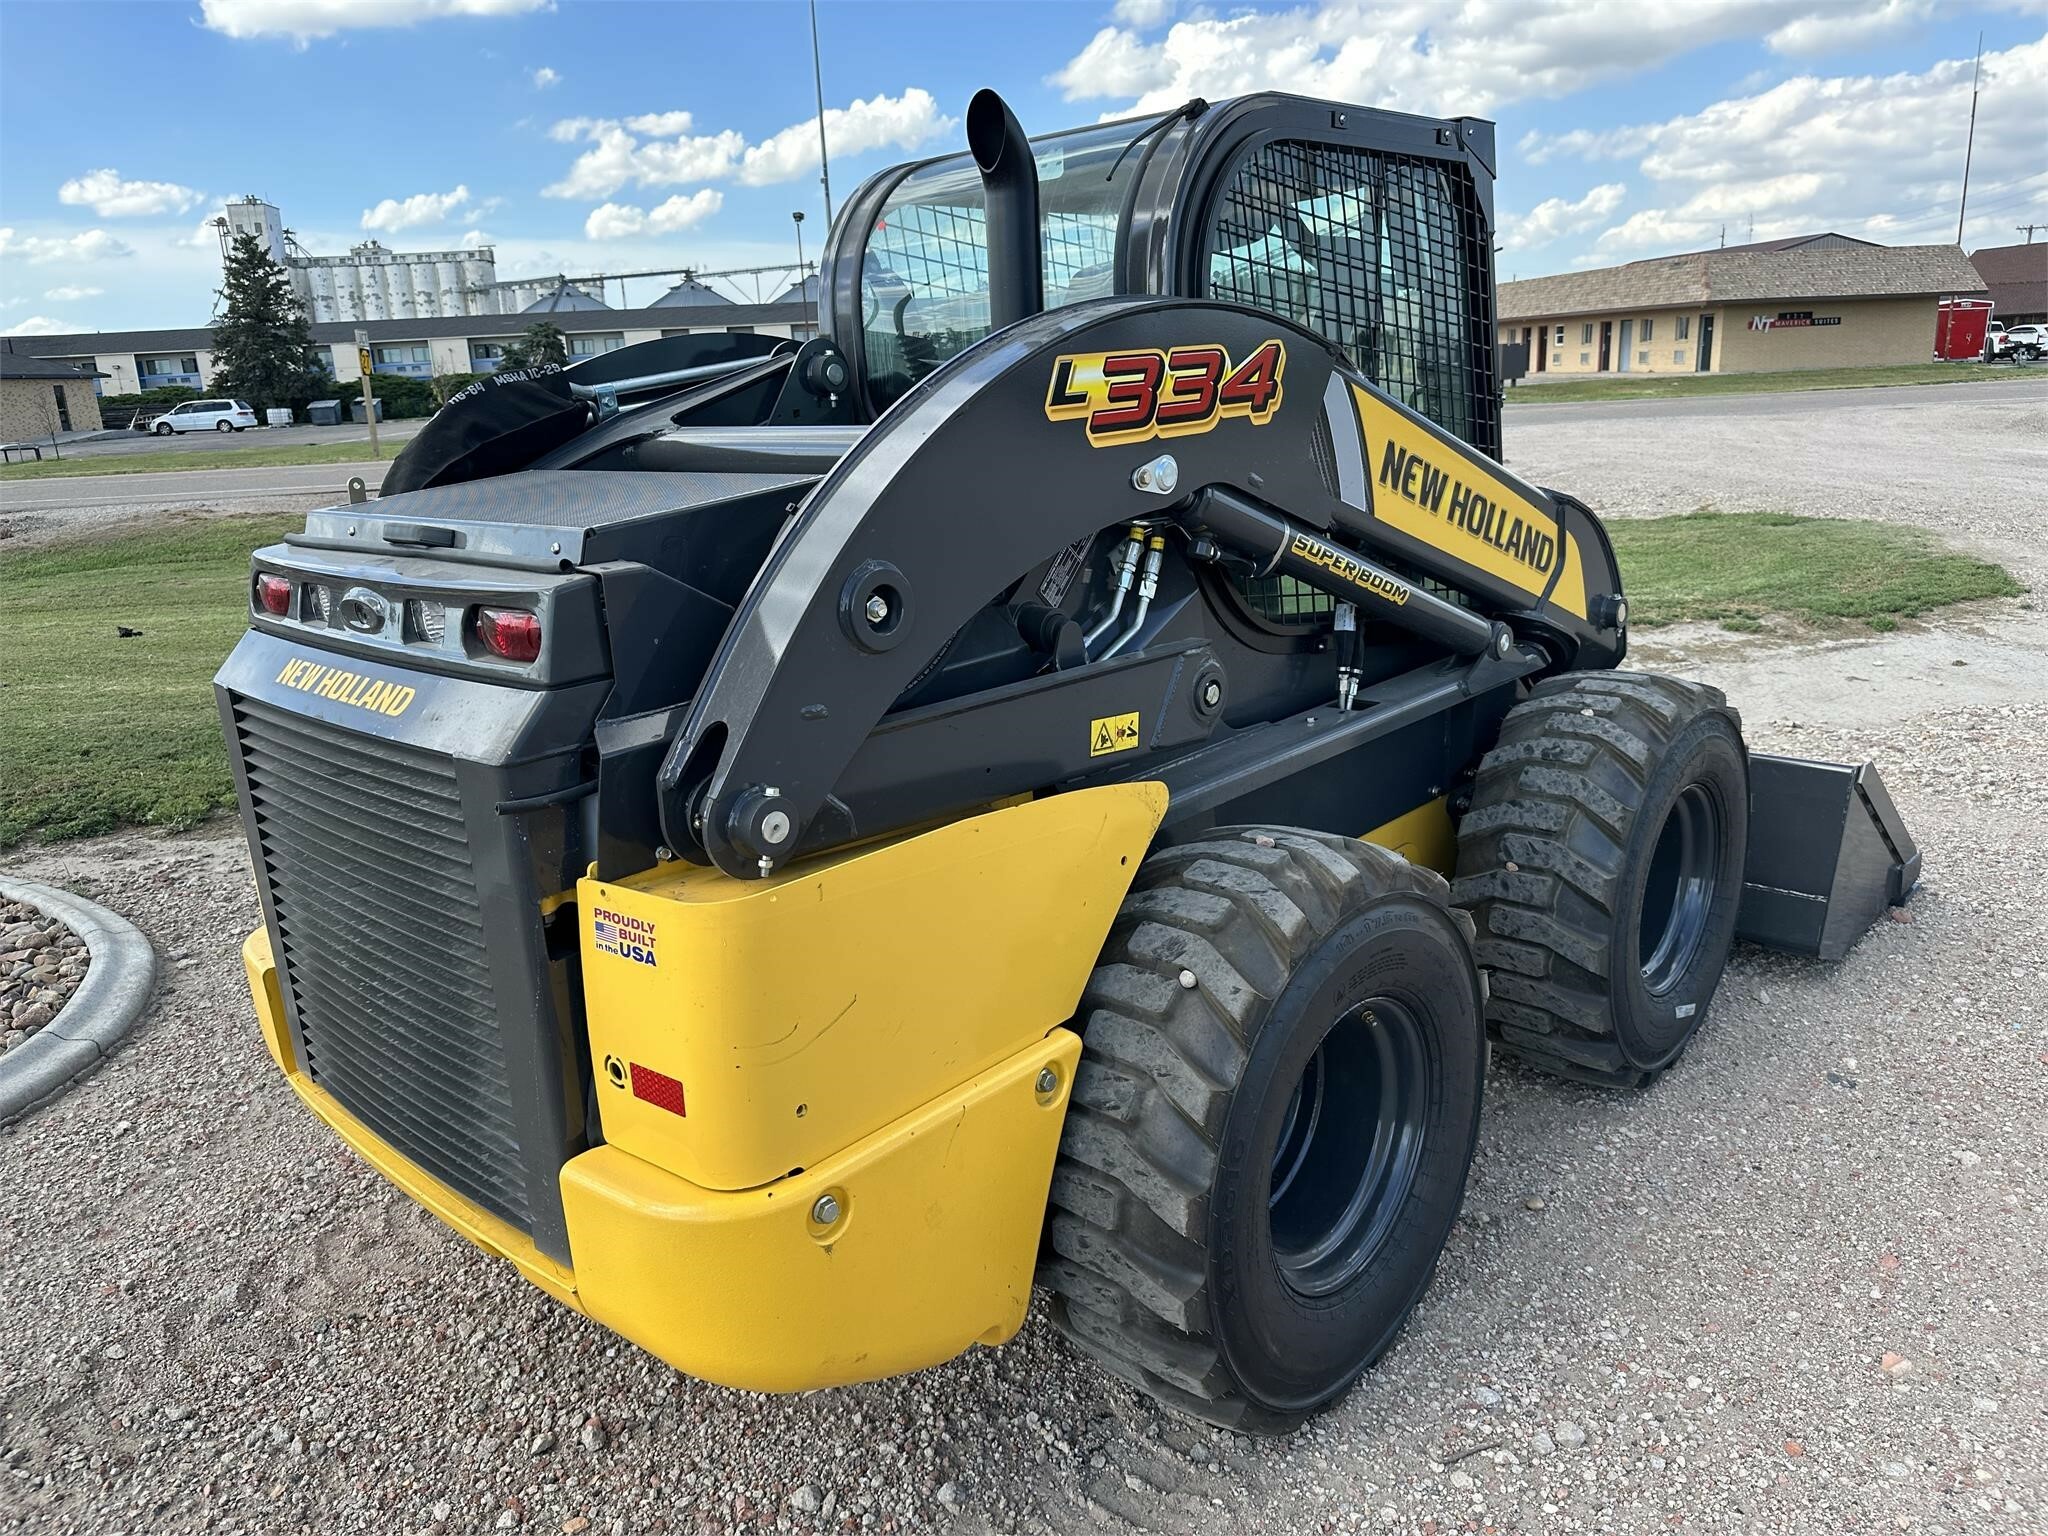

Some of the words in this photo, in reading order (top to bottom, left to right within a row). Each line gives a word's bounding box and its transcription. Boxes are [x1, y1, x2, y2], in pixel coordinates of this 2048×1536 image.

[493, 370, 528, 386] MSHA
[1045, 339, 1286, 447] L334
[1378, 439, 1449, 516] NEW
[1447, 480, 1555, 576] HOLLAND
[1292, 533, 1357, 579] SUPER
[1354, 565, 1410, 606] BOOM
[275, 658, 326, 691] NEW
[313, 668, 416, 717] HOLLAND
[594, 908, 655, 934] PROUDLY
[619, 928, 656, 948] BUILT
[596, 941, 604, 950] in
[604, 945, 618, 955] the
[619, 942, 657, 967] USA
